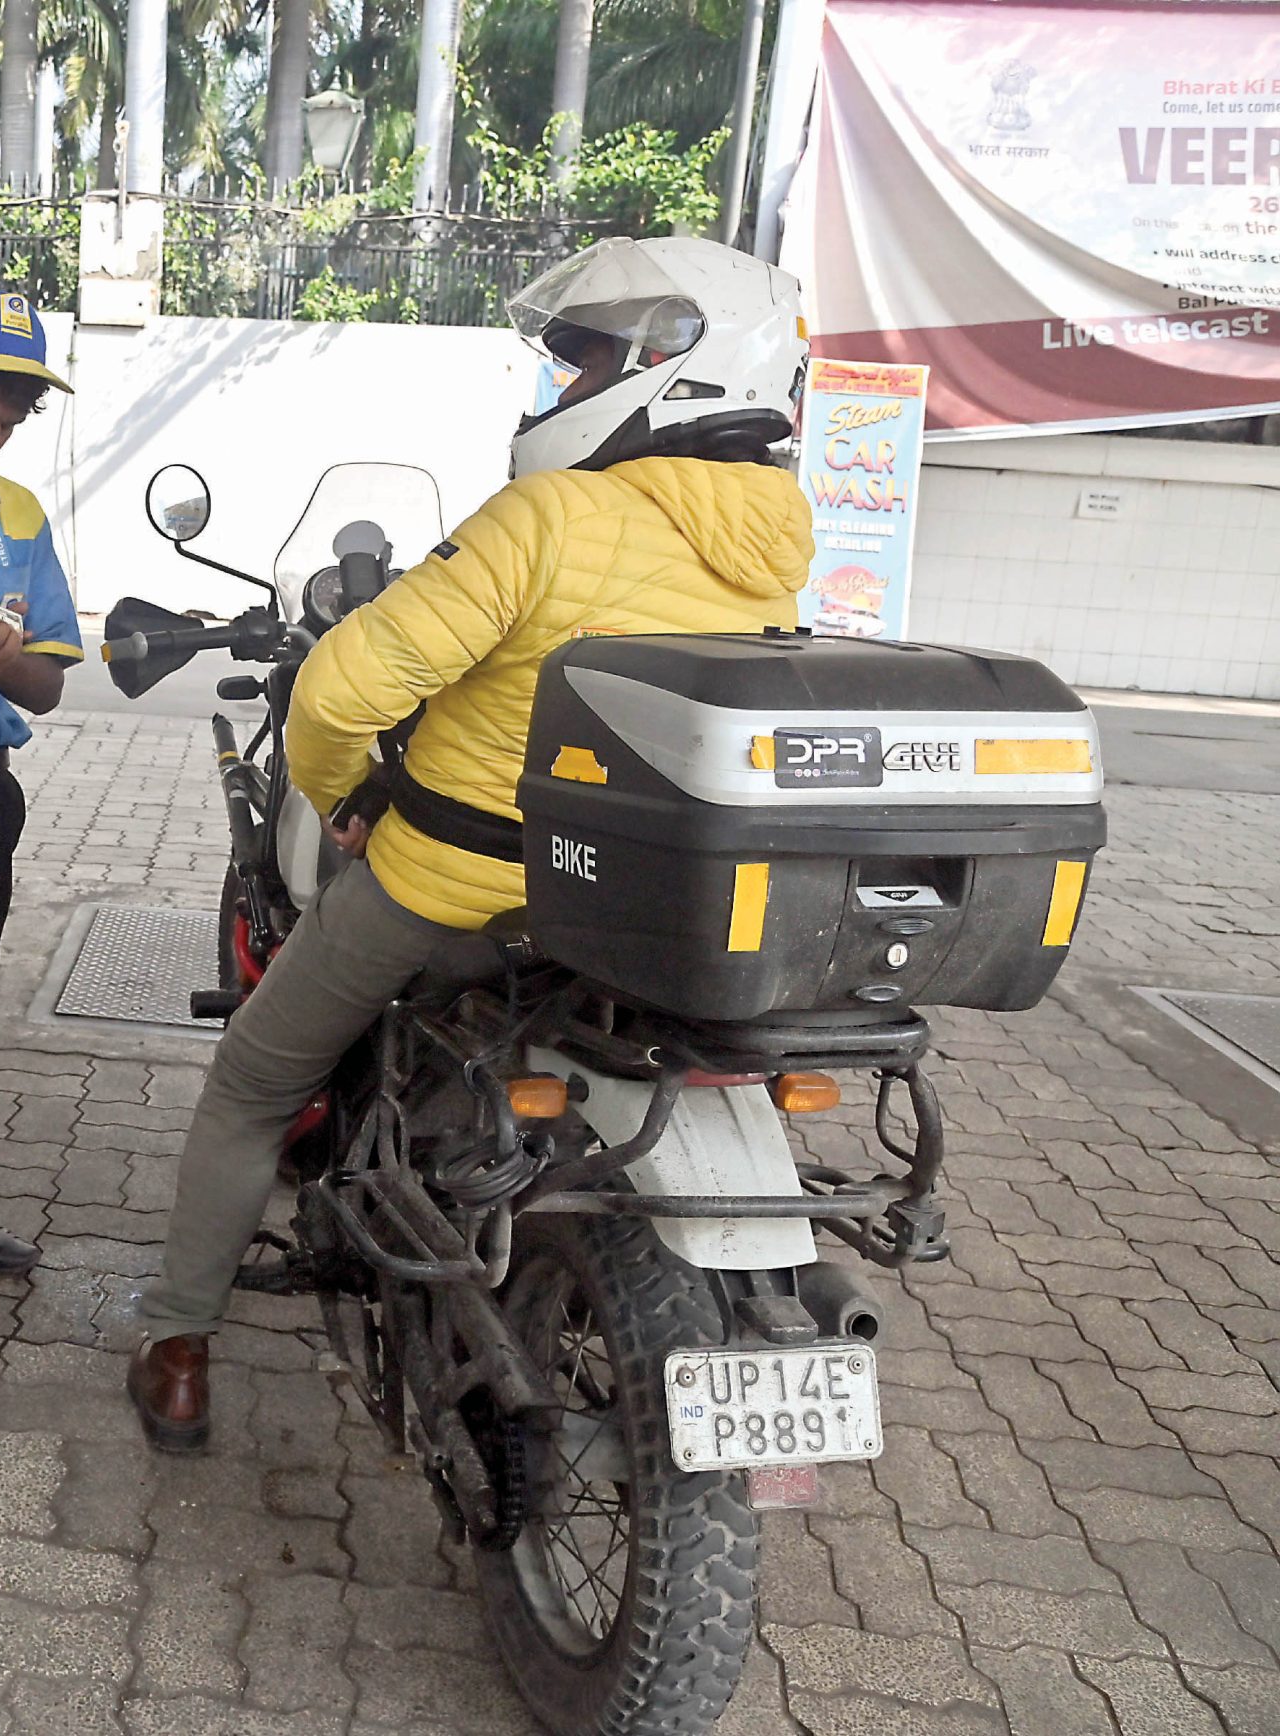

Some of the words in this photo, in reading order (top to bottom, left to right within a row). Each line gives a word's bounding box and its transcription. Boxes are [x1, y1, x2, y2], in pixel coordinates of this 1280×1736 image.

[1163, 79, 1238, 95] Bharat
[1244, 78, 1265, 95] Ki
[1162, 101, 1203, 115] Come,
[1206, 100, 1224, 113] let
[1228, 102, 1244, 113] us
[1118, 127, 1280, 185] VEER
[1199, 249, 1267, 263] address
[1042, 319, 1115, 350] Live
[1122, 311, 1270, 345] telecast
[824, 439, 897, 474] CAR
[809, 472, 909, 513] WASH
[787, 738, 866, 764] DPR
[882, 742, 960, 773] GIVI
[551, 834, 597, 882] BIKE
[680, 1405, 704, 1419] IND
